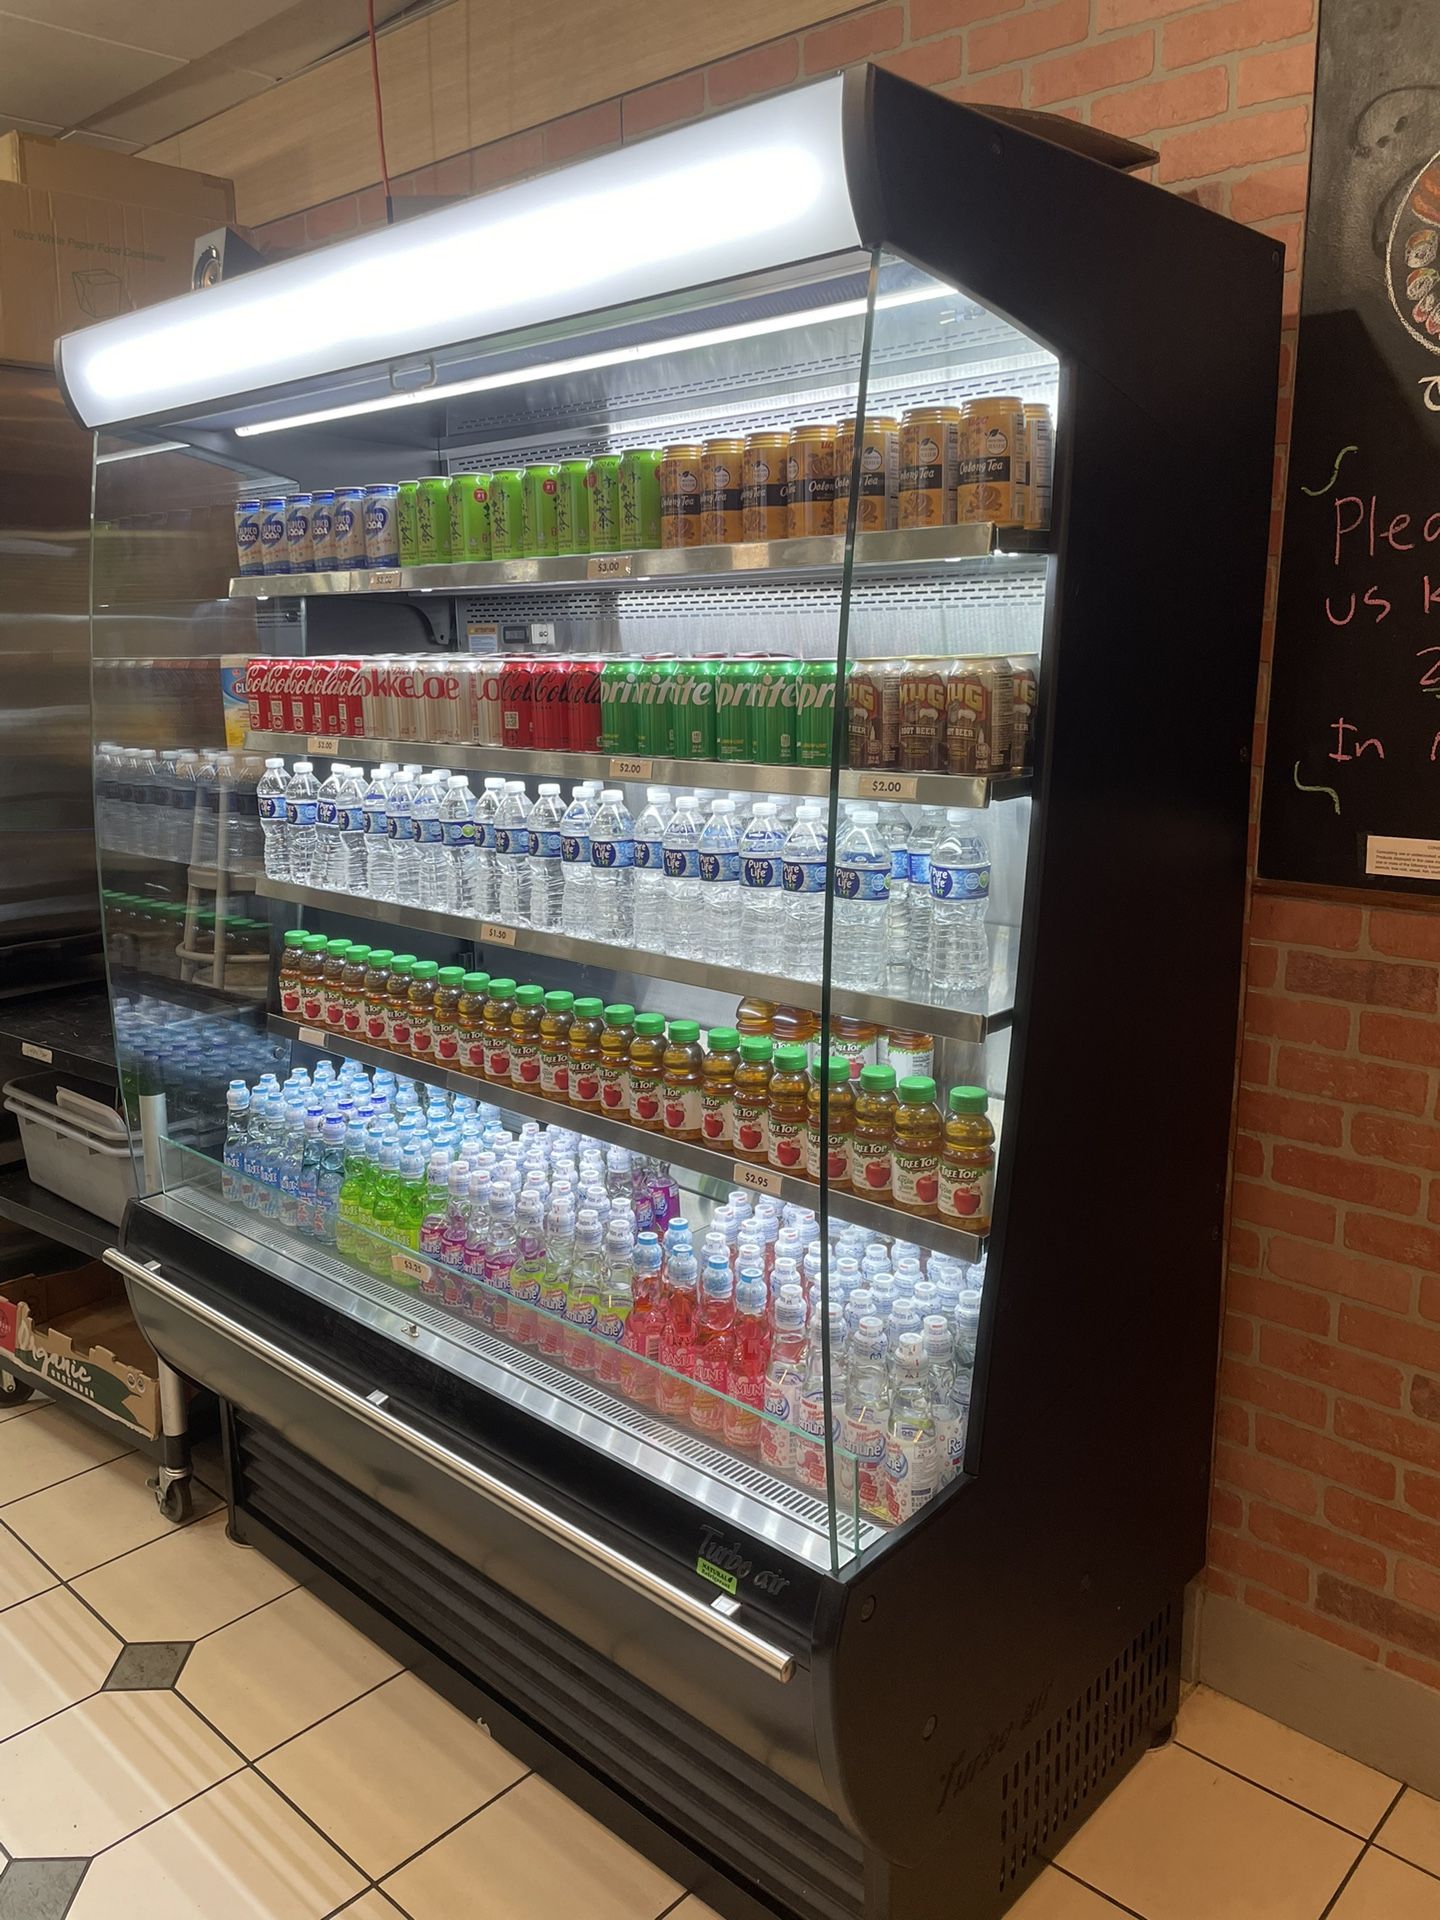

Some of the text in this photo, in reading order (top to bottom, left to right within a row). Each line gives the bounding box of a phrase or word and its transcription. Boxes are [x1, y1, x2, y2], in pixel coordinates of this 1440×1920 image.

[987, 458, 1003, 471] Tea
[920, 467, 935, 478] Tea
[863, 474, 878, 486] Tea
[915, 726, 936, 735] BEER
[1329, 717, 1385, 762] In
[619, 763, 641, 774] $2.00
[872, 780, 902, 793] $2.00
[594, 842, 612, 851] Pure
[596, 850, 610, 860] Life
[665, 850, 682, 860] Pure
[667, 859, 680, 869] Life
[701, 863, 714, 873] Life
[748, 859, 768, 870] Pure
[784, 863, 800, 873] Pure
[750, 868, 766, 879] Life
[784, 872, 798, 882] Life
[836, 868, 855, 880] Pure
[932, 868, 949, 880] Pure
[837, 877, 853, 889] Life
[933, 877, 946, 889] Life
[488, 928, 506, 939] $1.50
[745, 1171, 768, 1188] $2.95
[698, 1524, 753, 1578] Turbo
[702, 1563, 728, 1582] NATURAL
